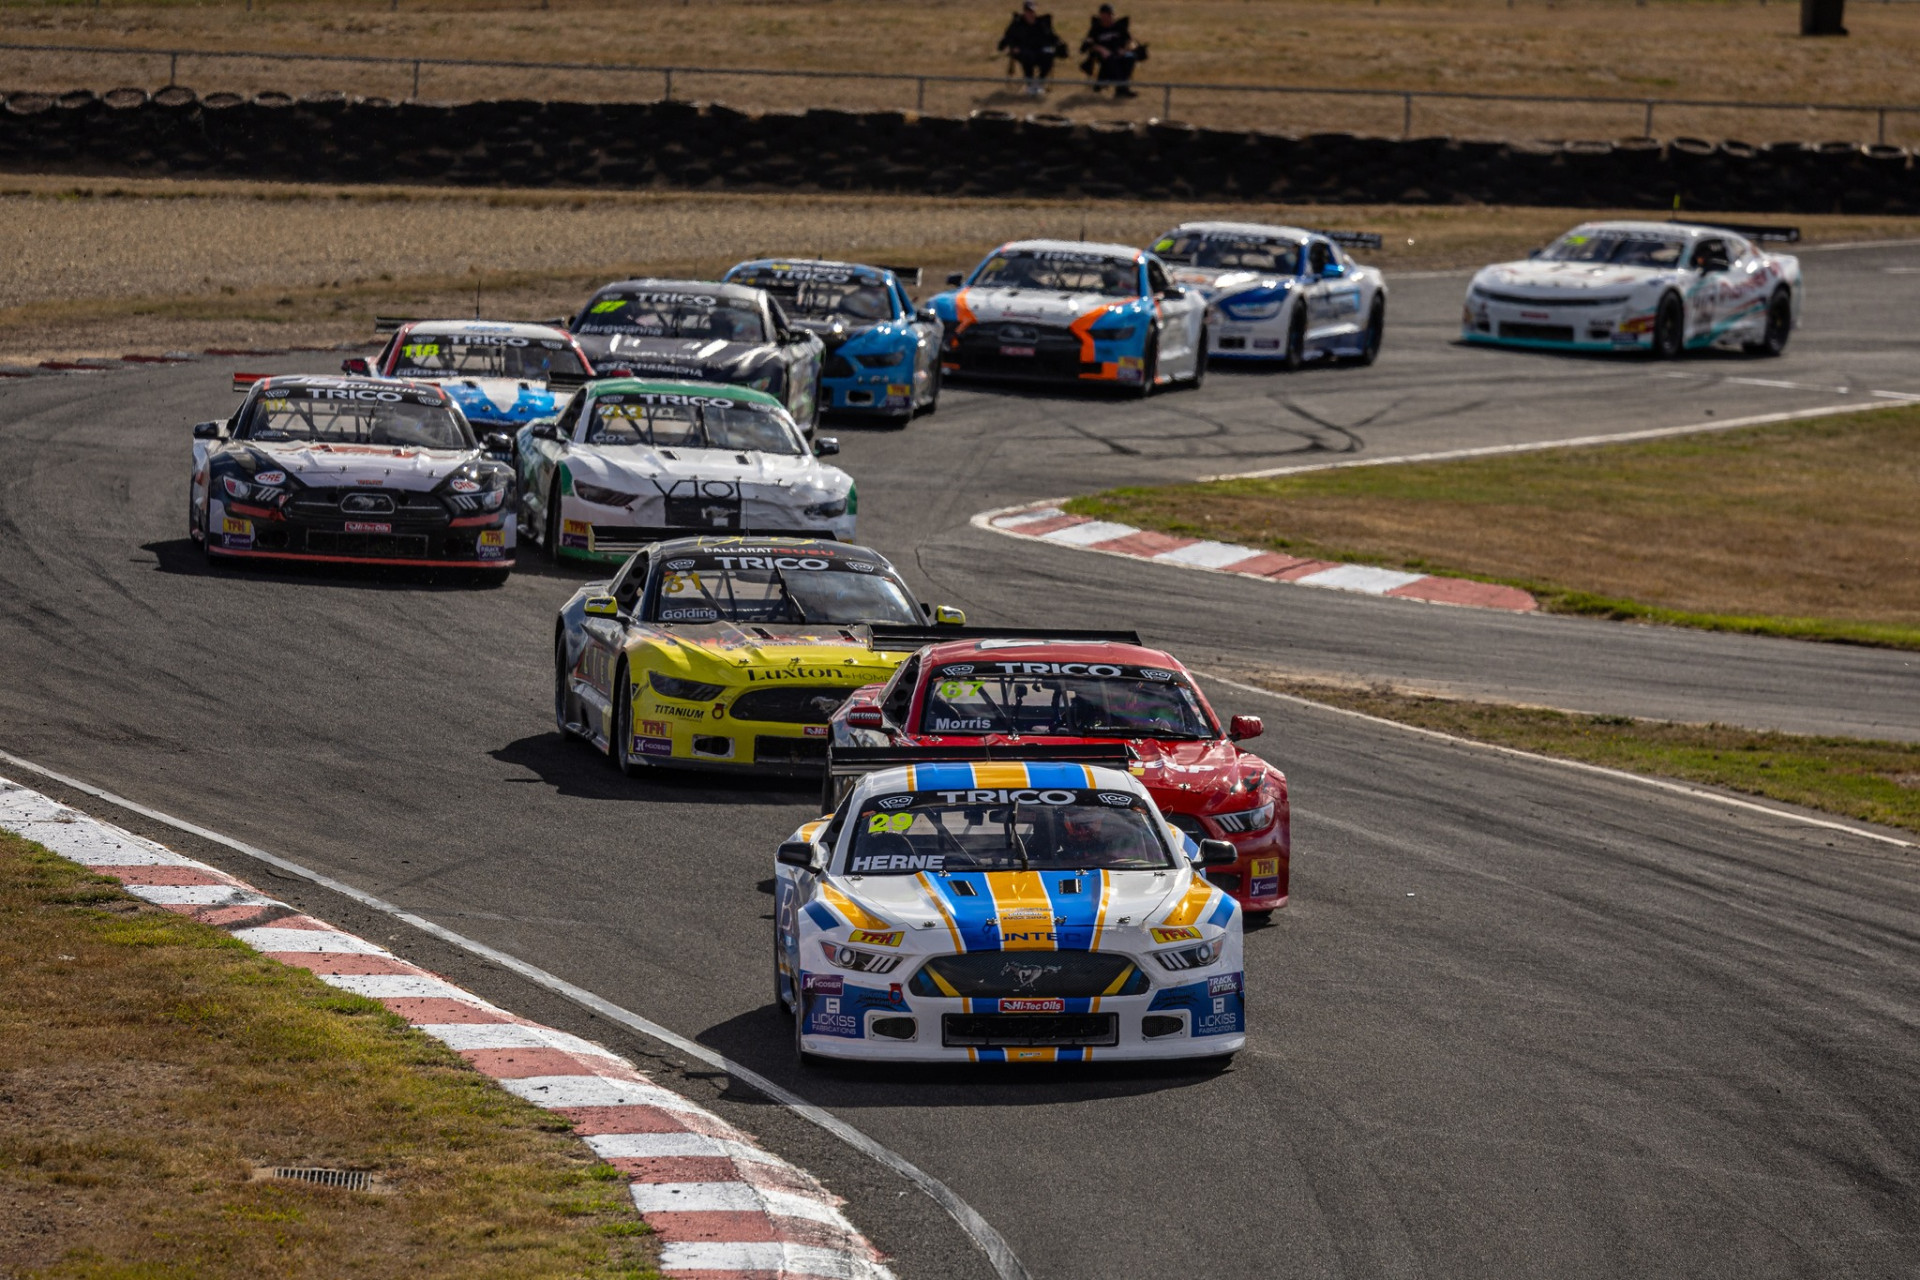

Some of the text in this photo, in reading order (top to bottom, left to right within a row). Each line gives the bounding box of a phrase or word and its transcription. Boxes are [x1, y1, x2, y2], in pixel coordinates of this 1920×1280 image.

[772, 270, 849, 283] TRICO
[636, 292, 717, 306] TRICO
[448, 335, 530, 347] TRICO
[402, 344, 439, 358] 118
[306, 388, 403, 402] TRICO
[640, 394, 735, 409] TRICO
[258, 473, 282, 482] CRE
[453, 481, 477, 490] CRE
[773, 548, 835, 556] ISUZU
[714, 556, 829, 571] TRICO
[664, 573, 702, 593] 31
[662, 608, 718, 620] Golding
[748, 667, 843, 682] Luxton
[995, 662, 1122, 677] TRICO
[940, 680, 986, 698] 67
[655, 704, 705, 719] TITANIUM
[642, 720, 665, 736] TFH
[935, 717, 992, 730] Morris
[937, 788, 1076, 805] TRICO
[869, 812, 913, 833] 29
[851, 854, 946, 871] HERNE
[860, 932, 893, 945] TFH
[1157, 929, 1189, 941] TFH
[1209, 976, 1233, 987] TRACK
[1211, 982, 1238, 993] ATTACK
[1011, 1001, 1061, 1010] Hi-Tec Oils
[812, 1013, 857, 1028] LICKISS
[1198, 1013, 1237, 1028] LICKISS
